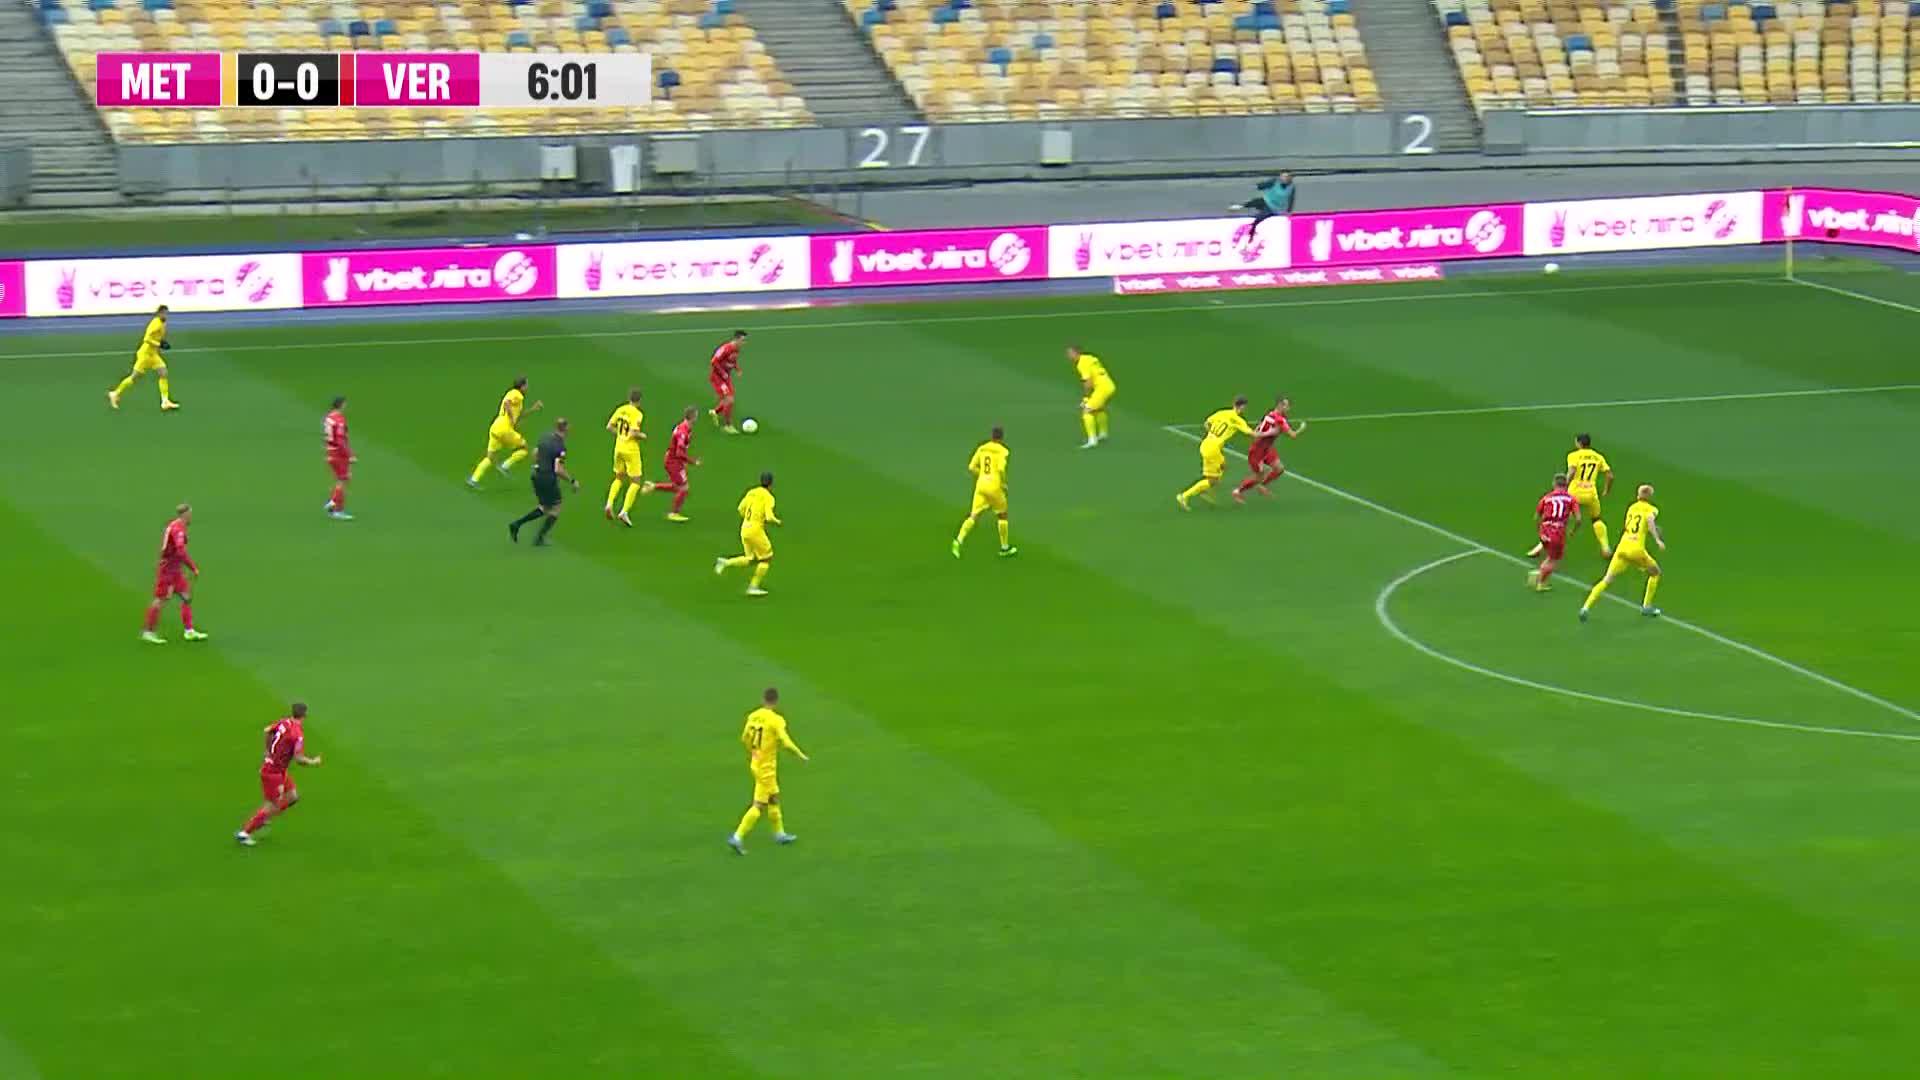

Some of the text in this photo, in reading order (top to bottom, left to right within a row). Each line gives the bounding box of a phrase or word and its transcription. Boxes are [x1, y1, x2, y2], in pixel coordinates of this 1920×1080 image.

[1402, 114, 1433, 154] 2
[860, 127, 930, 168] 27
[1807, 206, 1870, 231] vbet
[1337, 227, 1405, 251] vbet
[857, 248, 927, 273] vbet
[353, 266, 428, 292] vbet
[984, 455, 992, 474] 8
[1580, 462, 1596, 481] 17
[1626, 514, 1642, 534] 23
